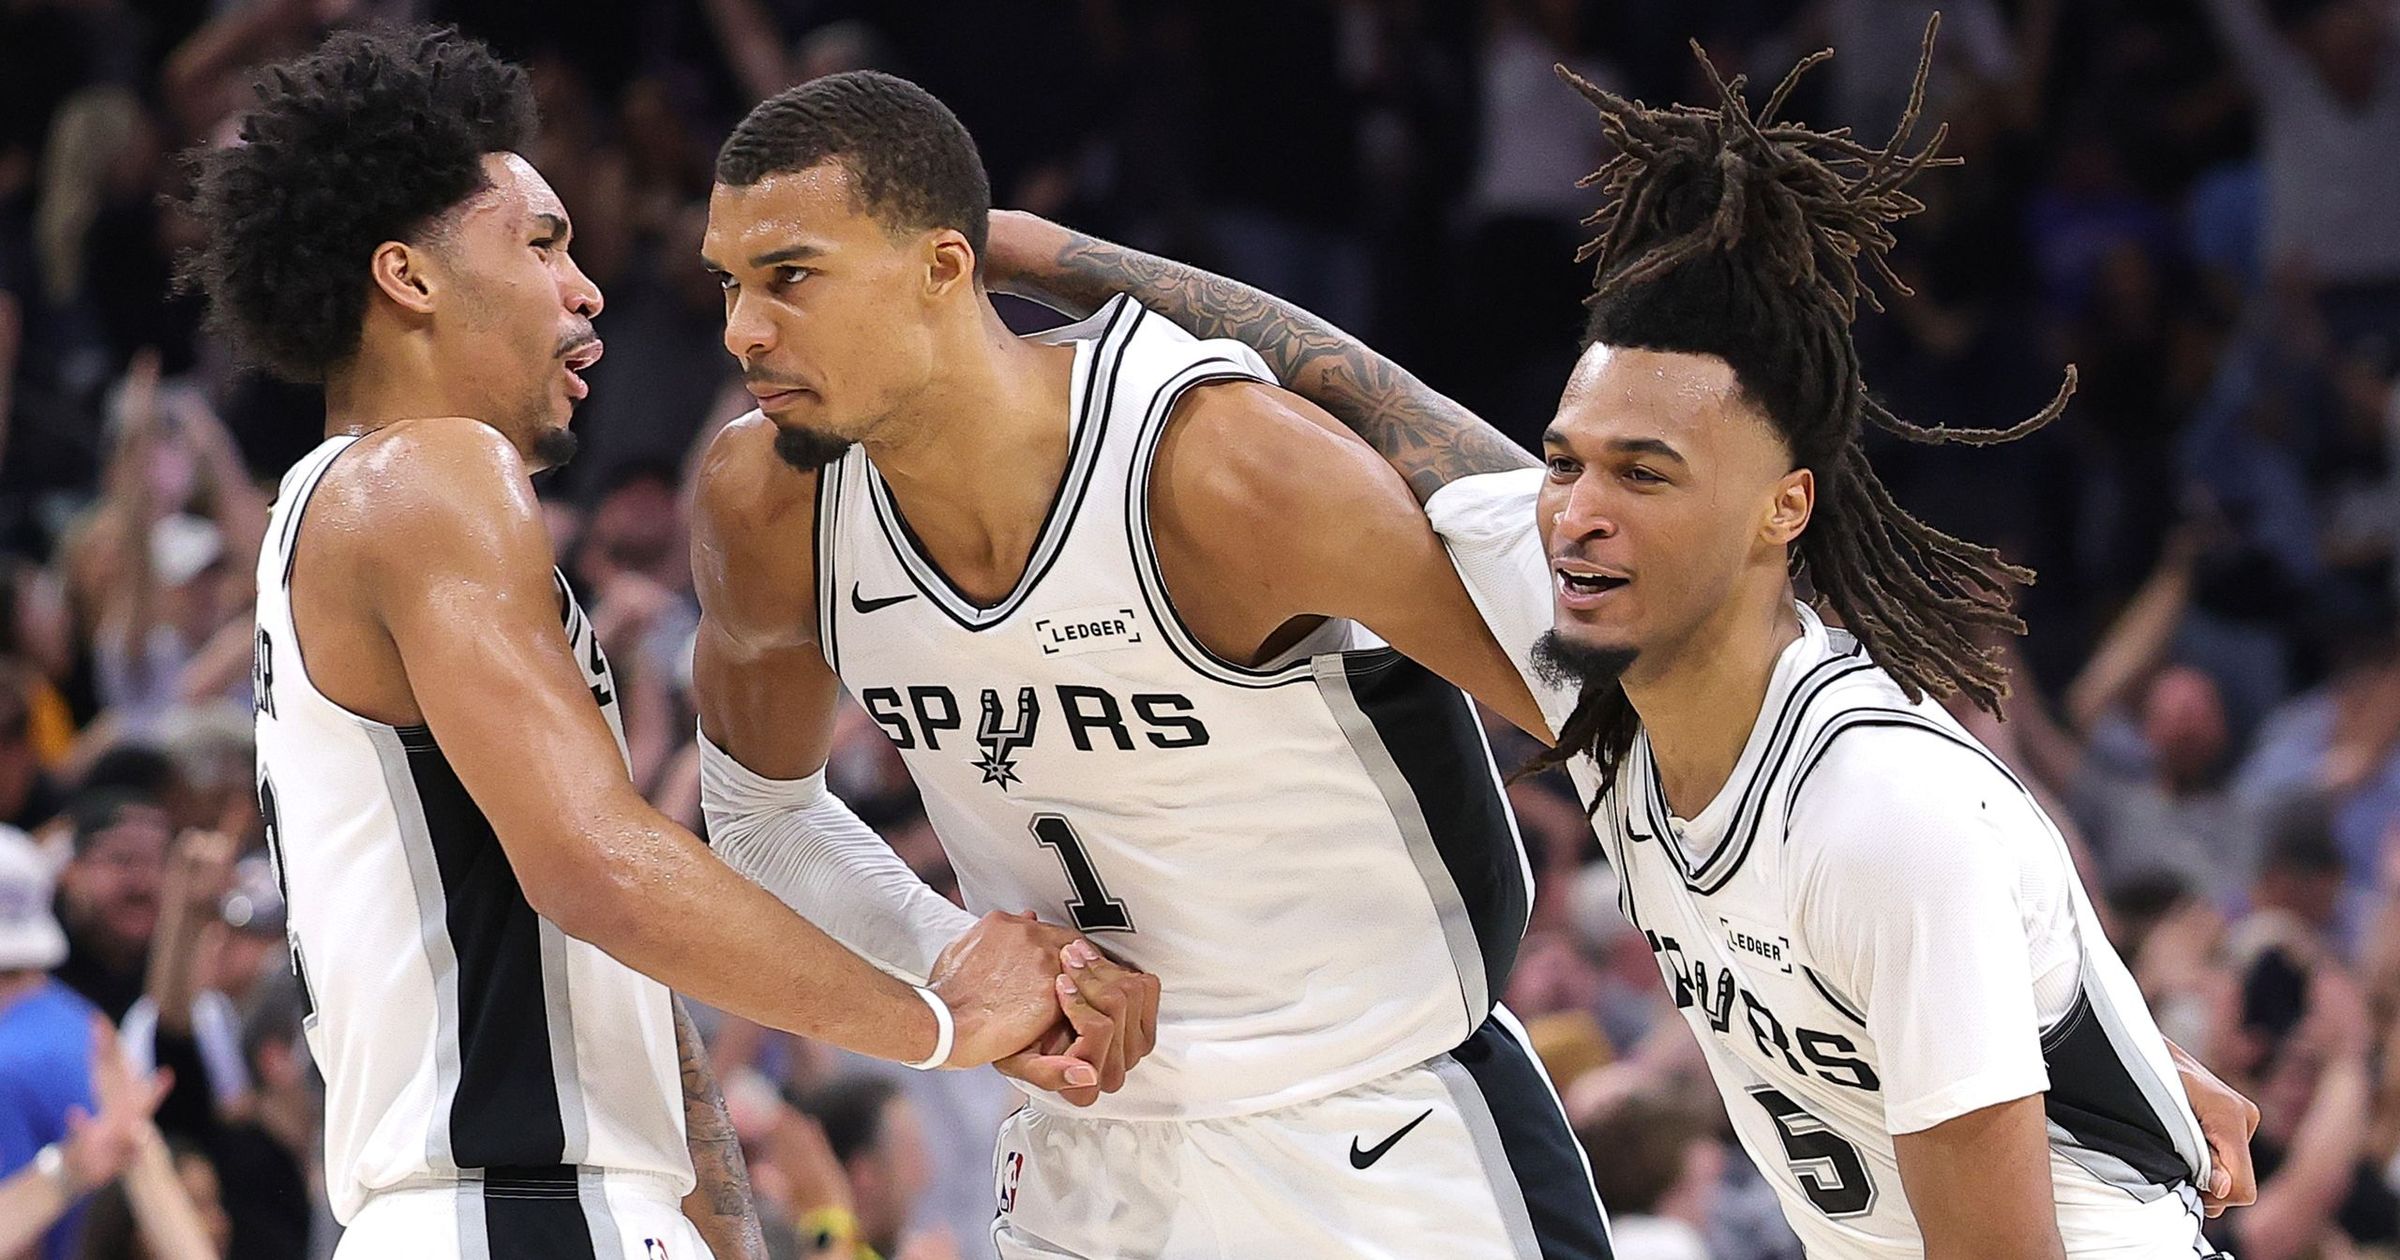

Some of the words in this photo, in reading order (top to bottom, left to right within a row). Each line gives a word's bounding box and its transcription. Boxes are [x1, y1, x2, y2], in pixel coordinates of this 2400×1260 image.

[1051, 618, 1127, 644] LEDGER
[862, 684, 1211, 793] SPURS
[1027, 812, 1137, 934] 1
[1729, 930, 1782, 962] LEDGER
[1645, 929, 1881, 1091] PURS
[1743, 1083, 1879, 1221] 5
